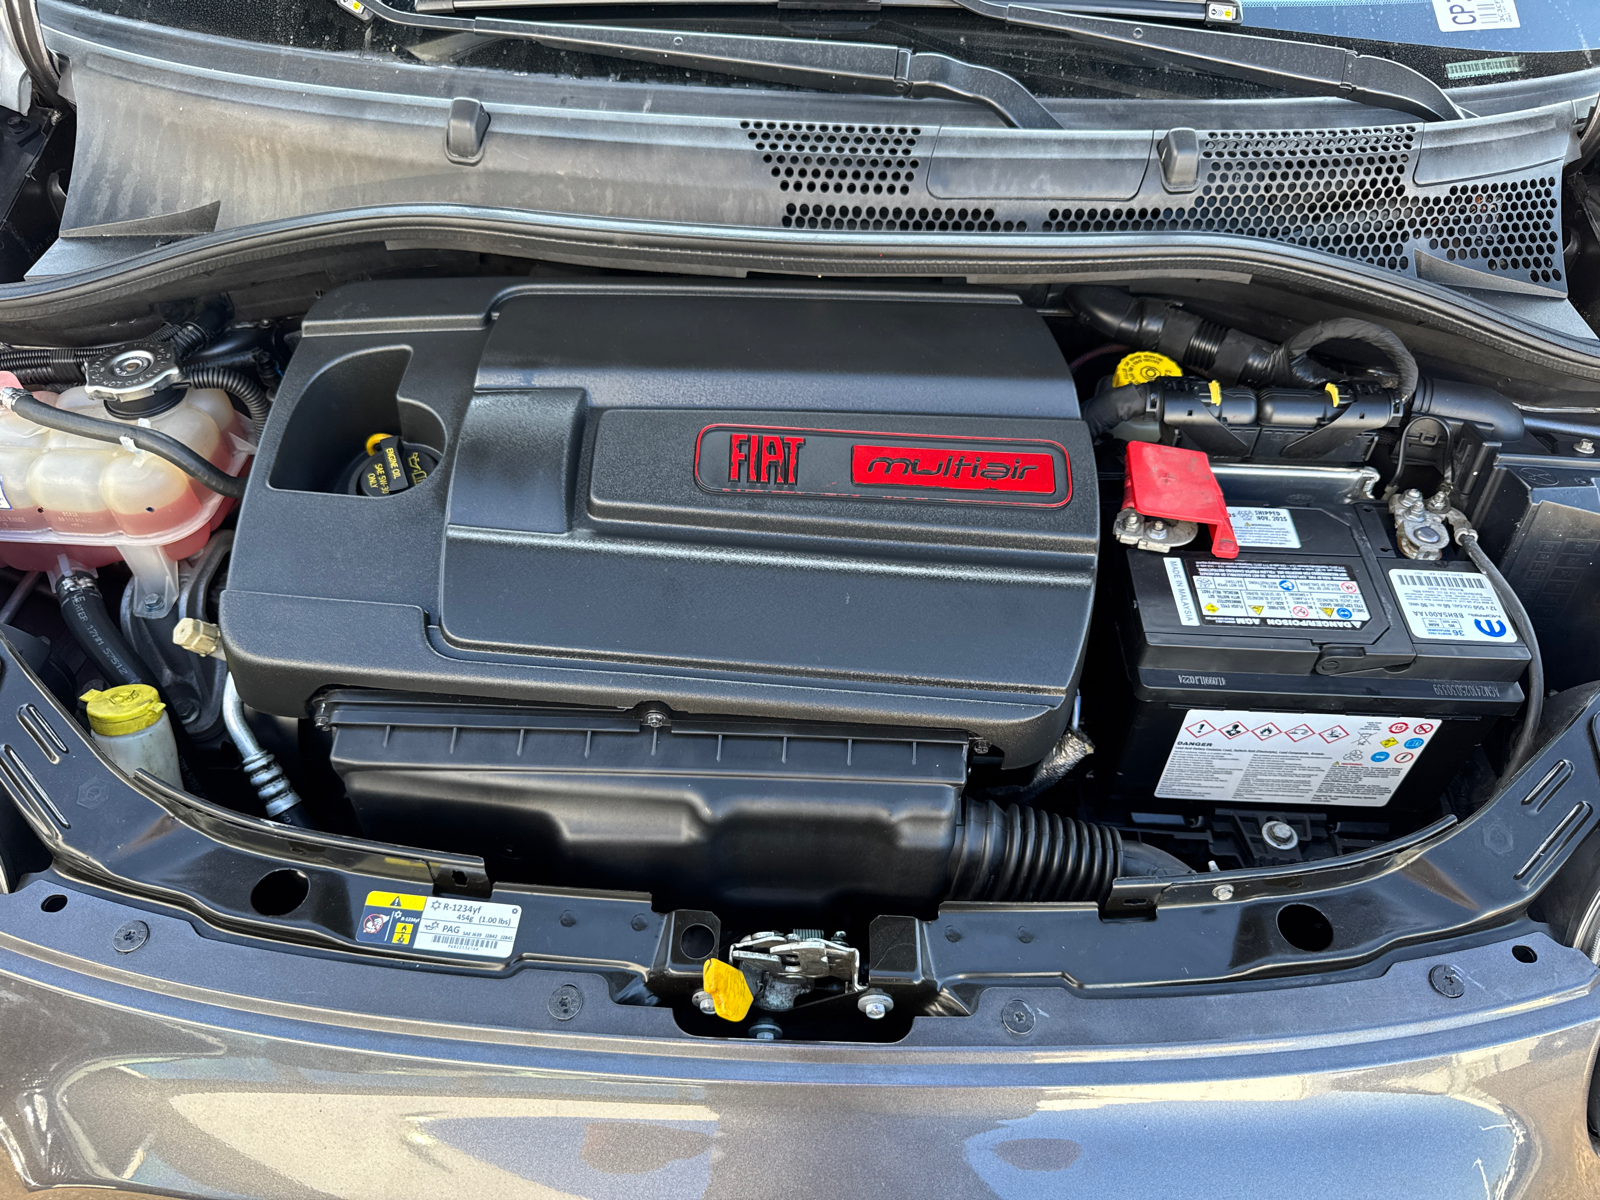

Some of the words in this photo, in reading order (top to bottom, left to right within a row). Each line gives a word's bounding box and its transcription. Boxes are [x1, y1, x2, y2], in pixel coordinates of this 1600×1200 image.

[386, 447, 399, 469] ENGINE
[728, 434, 806, 486] FIAT
[374, 463, 384, 475] SAE
[392, 468, 402, 480] OIL
[867, 455, 1038, 481] multiair
[367, 473, 378, 488] ONLY
[378, 474, 390, 494] 5W-30
[1170, 560, 1182, 579] MADE
[1178, 588, 1194, 622] MALAYSIA
[1266, 618, 1352, 628] DANGER/POISON
[71, 595, 88, 622] HEATER
[103, 647, 128, 675] 57512
[443, 902, 482, 915] R-1234yf
[456, 914, 474, 923] 454g
[479, 915, 497, 924] (1.00
[498, 916, 512, 926] lbs)
[442, 924, 460, 934] PAG
